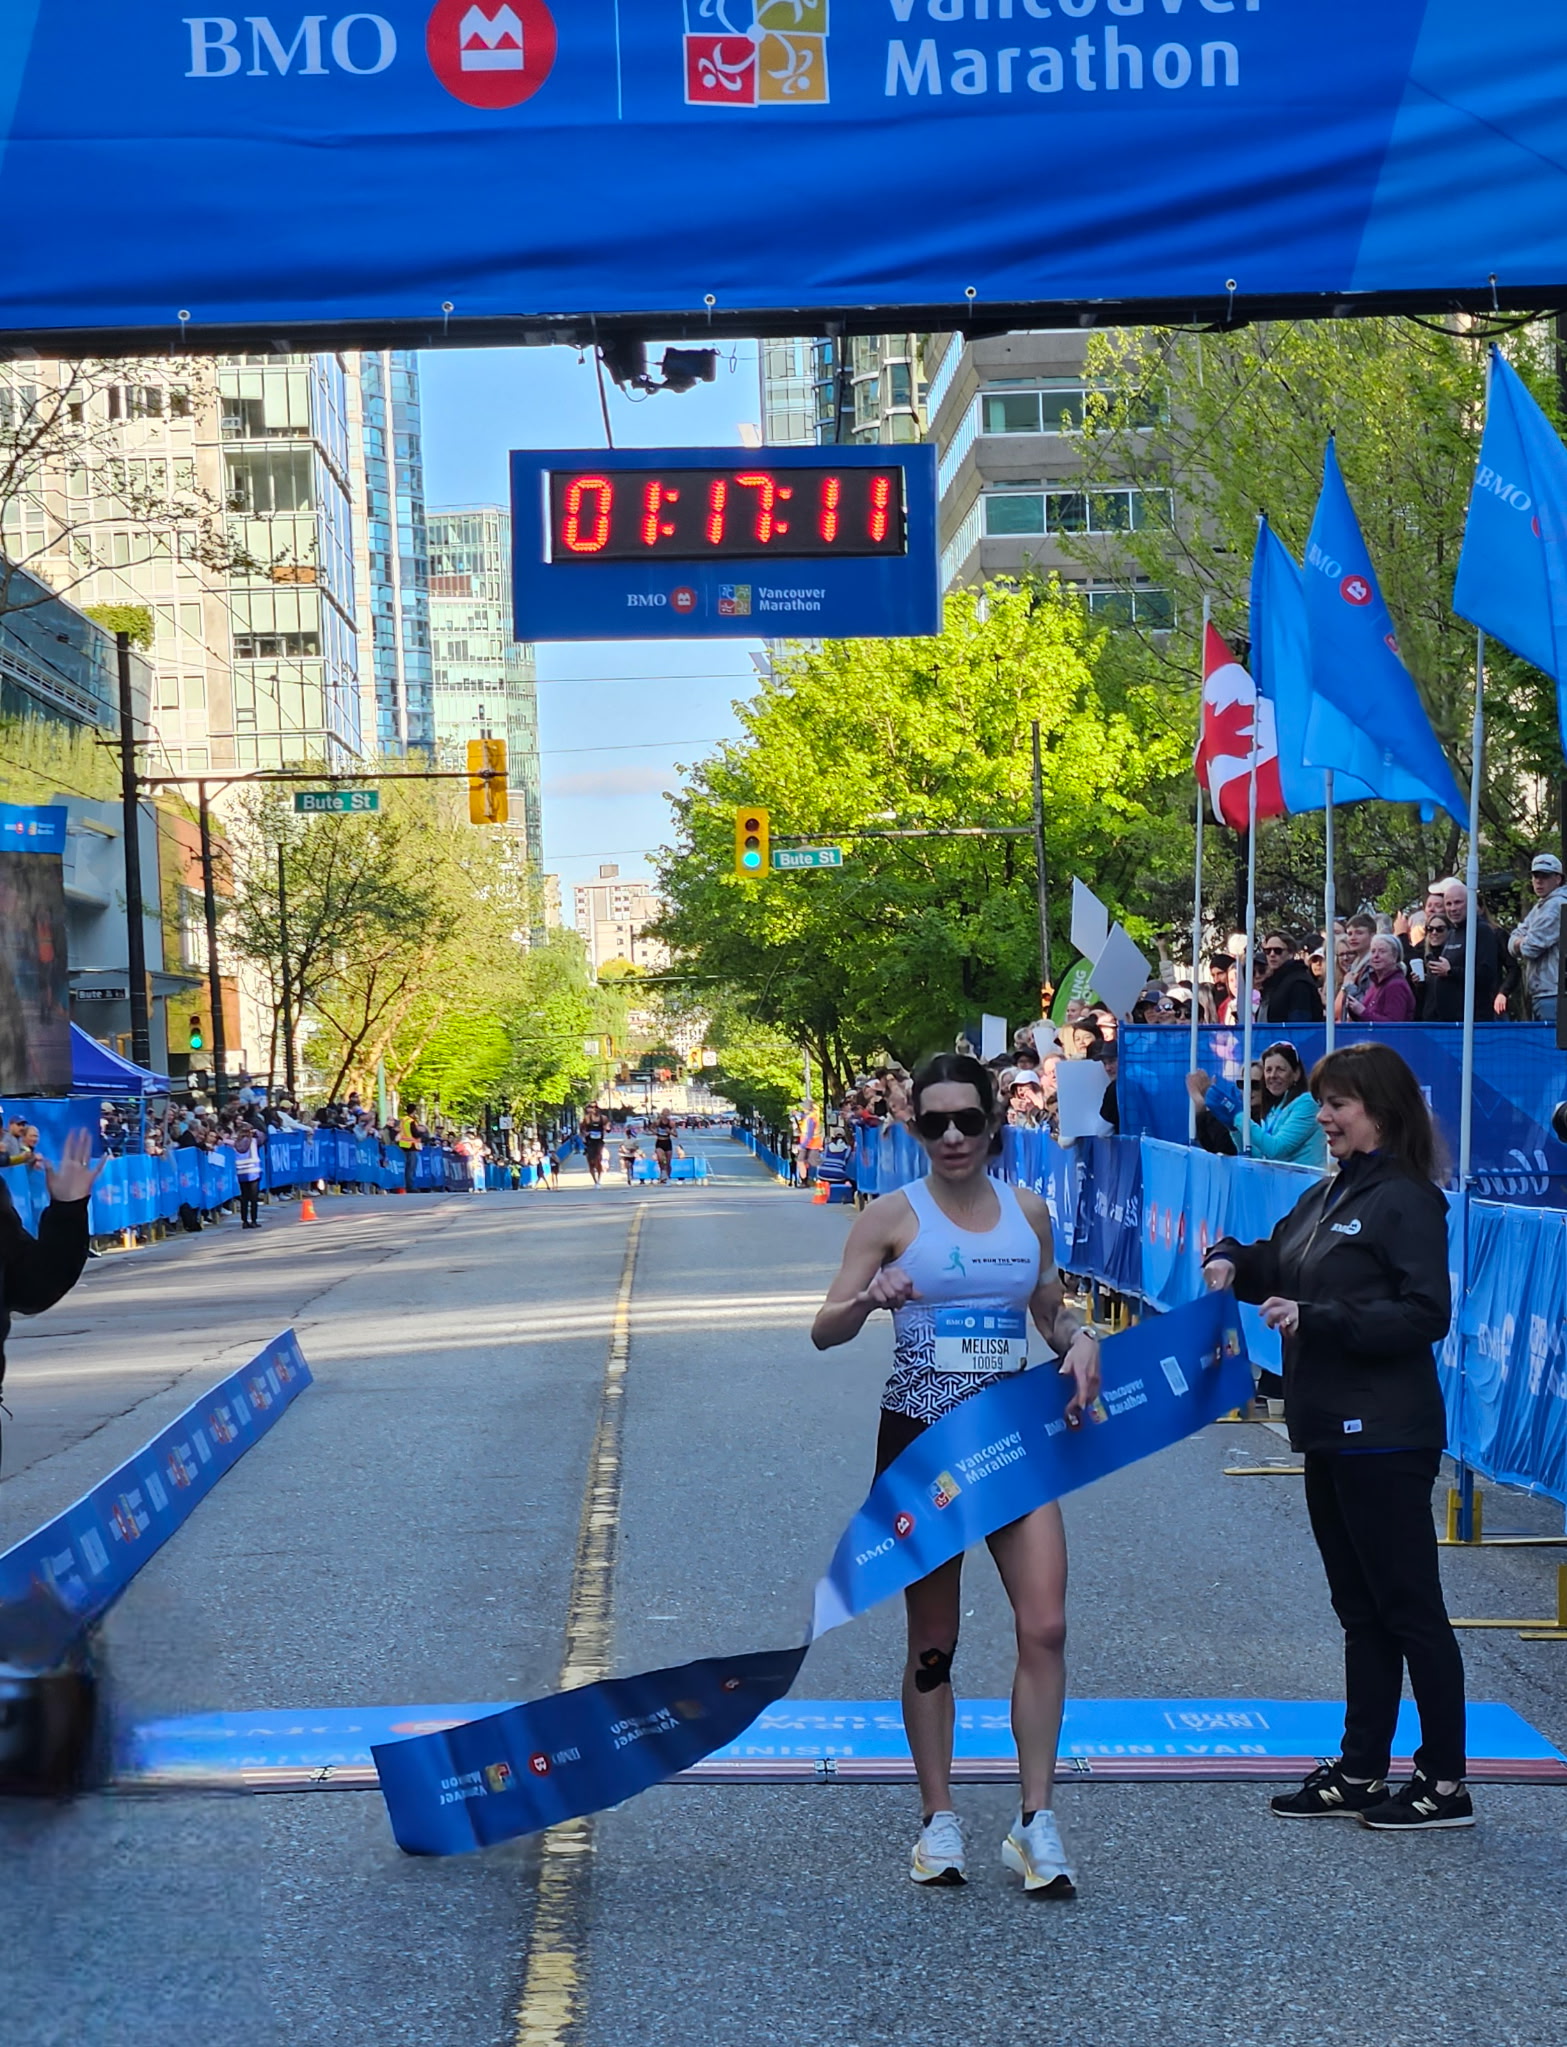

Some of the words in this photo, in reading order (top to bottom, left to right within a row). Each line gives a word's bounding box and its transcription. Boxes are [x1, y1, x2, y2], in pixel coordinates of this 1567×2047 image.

[181, 13, 397, 77] BMO
[884, 25, 1240, 96] Marathon
[1475, 464, 1532, 511] BMO
[627, 593, 667, 607] BMO
[758, 587, 826, 599] Vancouver
[759, 599, 821, 612] Marathon
[303, 794, 344, 810] Bute
[350, 792, 371, 809] St
[780, 853, 813, 866] Bute
[818, 851, 836, 864] St
[1070, 969, 1087, 1000] LING
[962, 1338, 1010, 1355] MELISSA
[955, 1431, 1022, 1472] Vancouver
[965, 1446, 1027, 1485] Marathon
[855, 1537, 895, 1566] BMO
[730, 1746, 853, 1756] INISH
[1184, 1744, 1267, 1755] VAN
